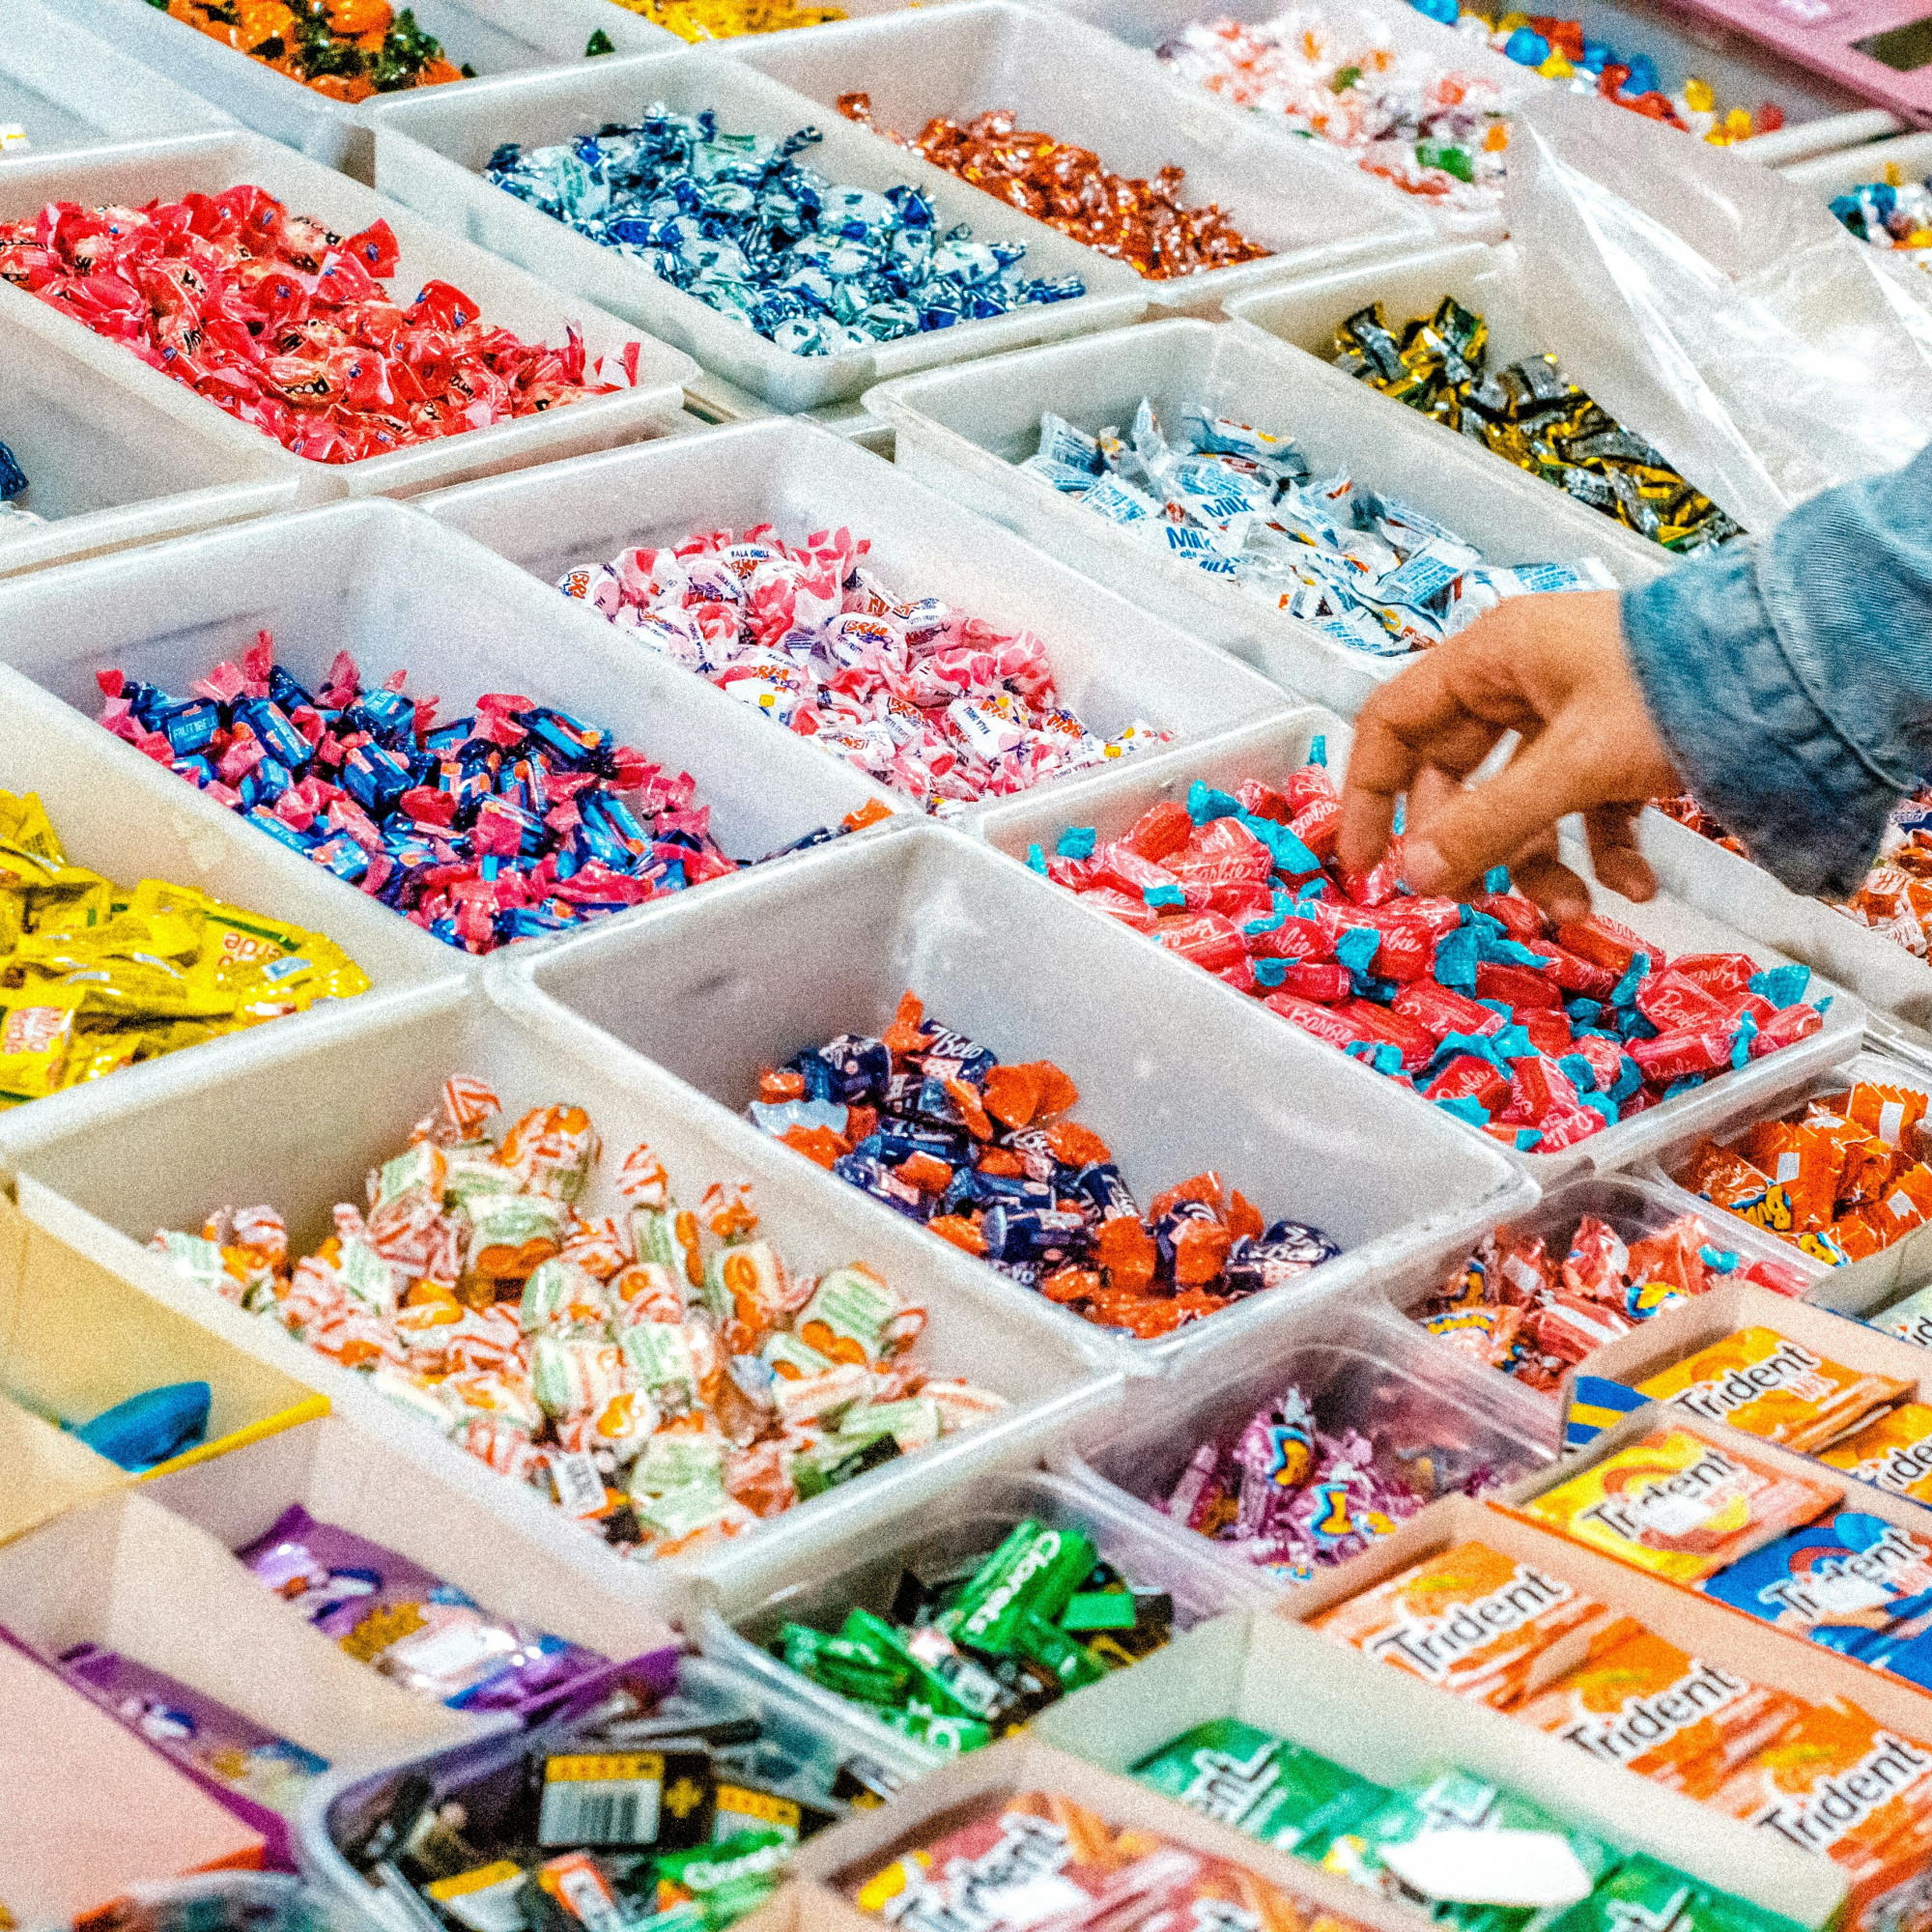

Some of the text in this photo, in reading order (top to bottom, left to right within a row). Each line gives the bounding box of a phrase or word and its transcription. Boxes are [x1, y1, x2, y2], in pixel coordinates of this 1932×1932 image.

[1201, 495, 1255, 518] Milk
[930, 1024, 984, 1060] 7Belo
[1674, 1343, 1815, 1420] Trident
[1581, 1451, 1737, 1540] Trent
[965, 1530, 1062, 1635] Clorets
[1765, 1532, 1921, 1618] Trent
[1372, 1571, 1564, 1673] Trident
[1562, 1663, 1740, 1760] Trident
[1756, 1738, 1924, 1854] Trident
